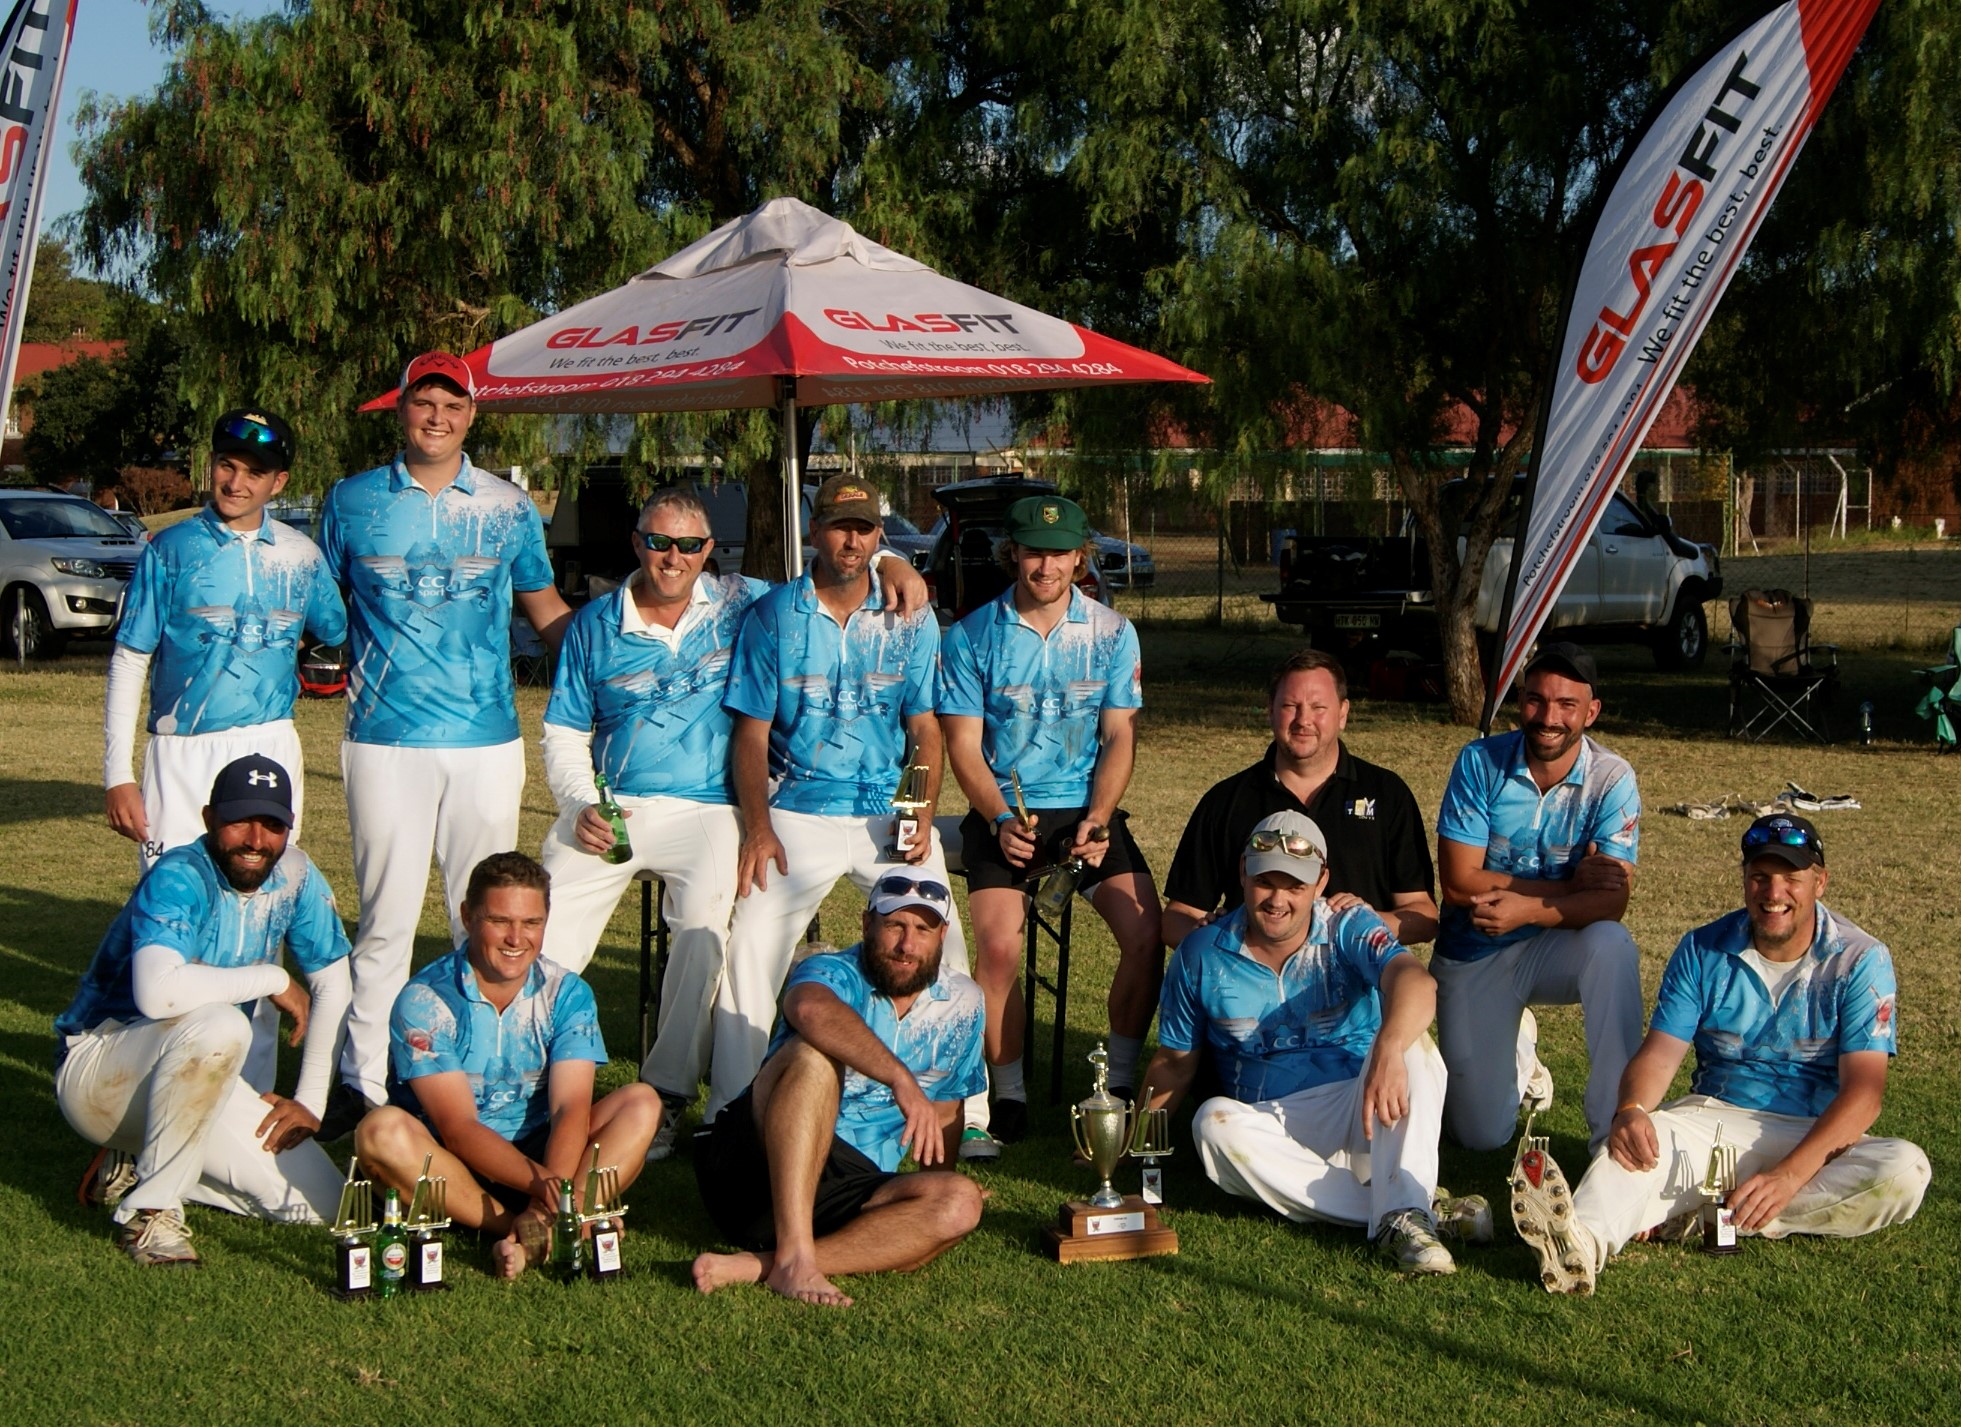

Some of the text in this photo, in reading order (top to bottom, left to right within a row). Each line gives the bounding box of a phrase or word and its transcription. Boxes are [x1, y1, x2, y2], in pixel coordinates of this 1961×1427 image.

[1576, 50, 1761, 384] GLASFIT
[1637, 124, 1783, 365] We fit the best, best.
[823, 308, 1020, 334] GLASFIT
[546, 307, 763, 349] GLASFIT
[879, 339, 909, 350] We
[909, 339, 926, 350] fit
[927, 340, 954, 351] the
[549, 357, 574, 369] We
[575, 356, 596, 368] fit
[597, 355, 623, 367] the
[842, 356, 1123, 376] Potchefstroom 018 294 4284
[599, 372, 646, 388] 018
[643, 368, 684, 383] 294
[687, 360, 747, 377] 4284
[418, 576, 446, 588] CC
[417, 587, 445, 598] sport
[242, 624, 263, 636] CC
[241, 635, 263, 644] sport
[837, 690, 857, 703] CC
[837, 702, 858, 712] sport
[1041, 698, 1060, 709] CC
[1517, 856, 1540, 868] CC
[490, 1090, 516, 1103] CC
